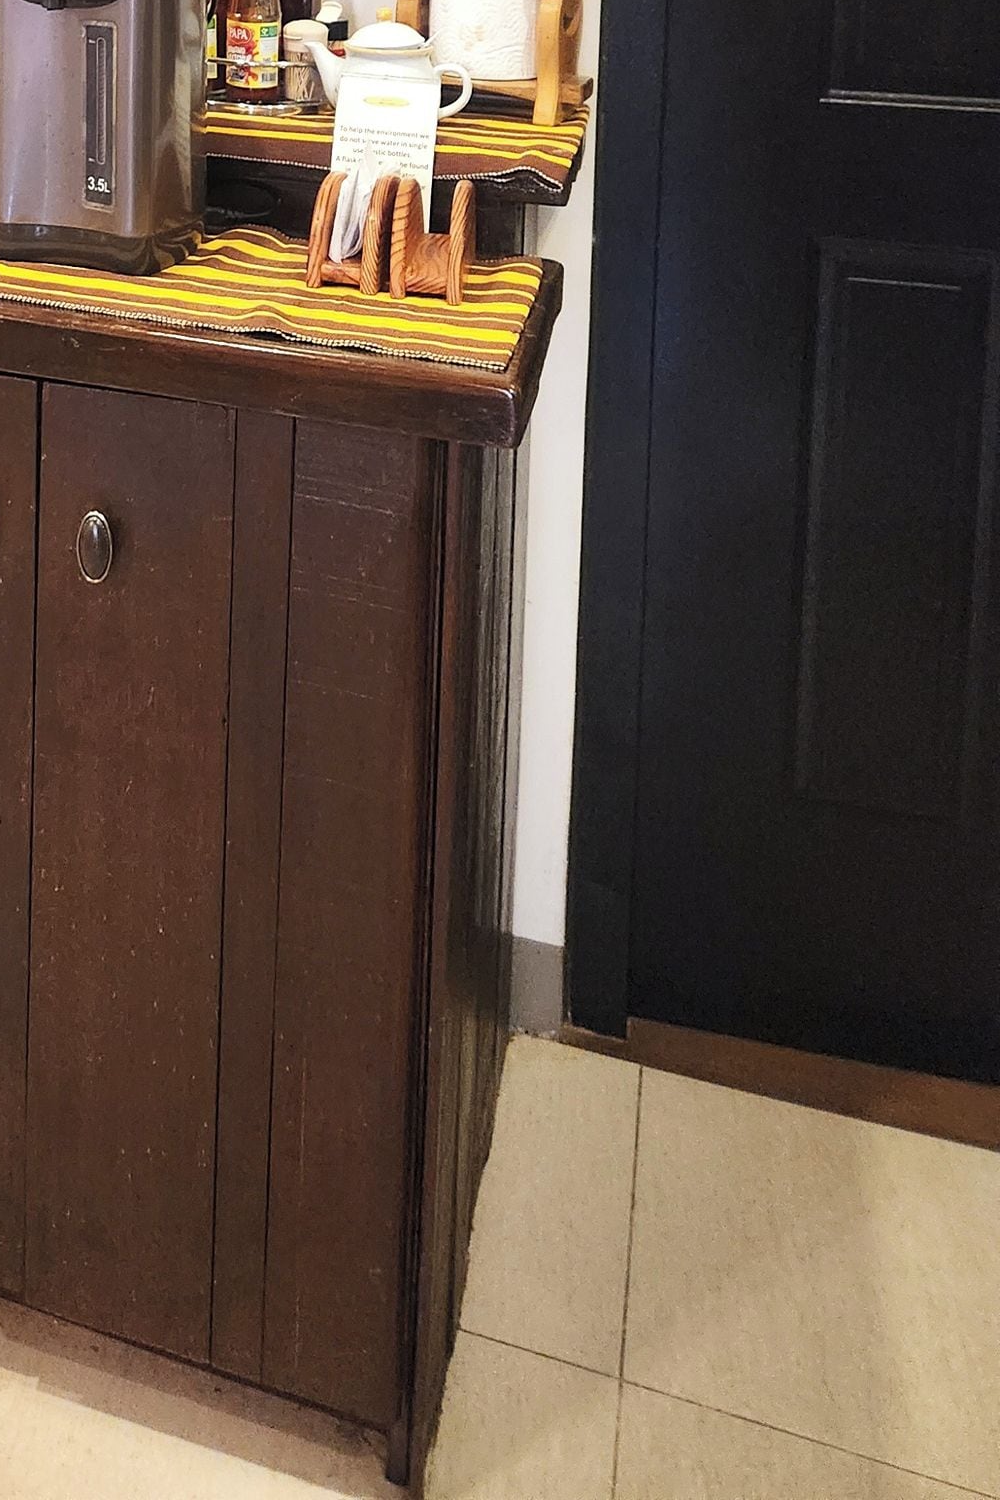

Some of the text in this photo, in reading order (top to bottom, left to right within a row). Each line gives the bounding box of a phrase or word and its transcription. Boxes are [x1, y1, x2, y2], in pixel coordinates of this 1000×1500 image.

[230, 27, 248, 40] PAPA
[349, 126, 363, 134] help
[377, 130, 418, 138] environment
[409, 142, 428, 150] single
[409, 162, 429, 170] found
[88, 176, 111, 193] 3.5L
